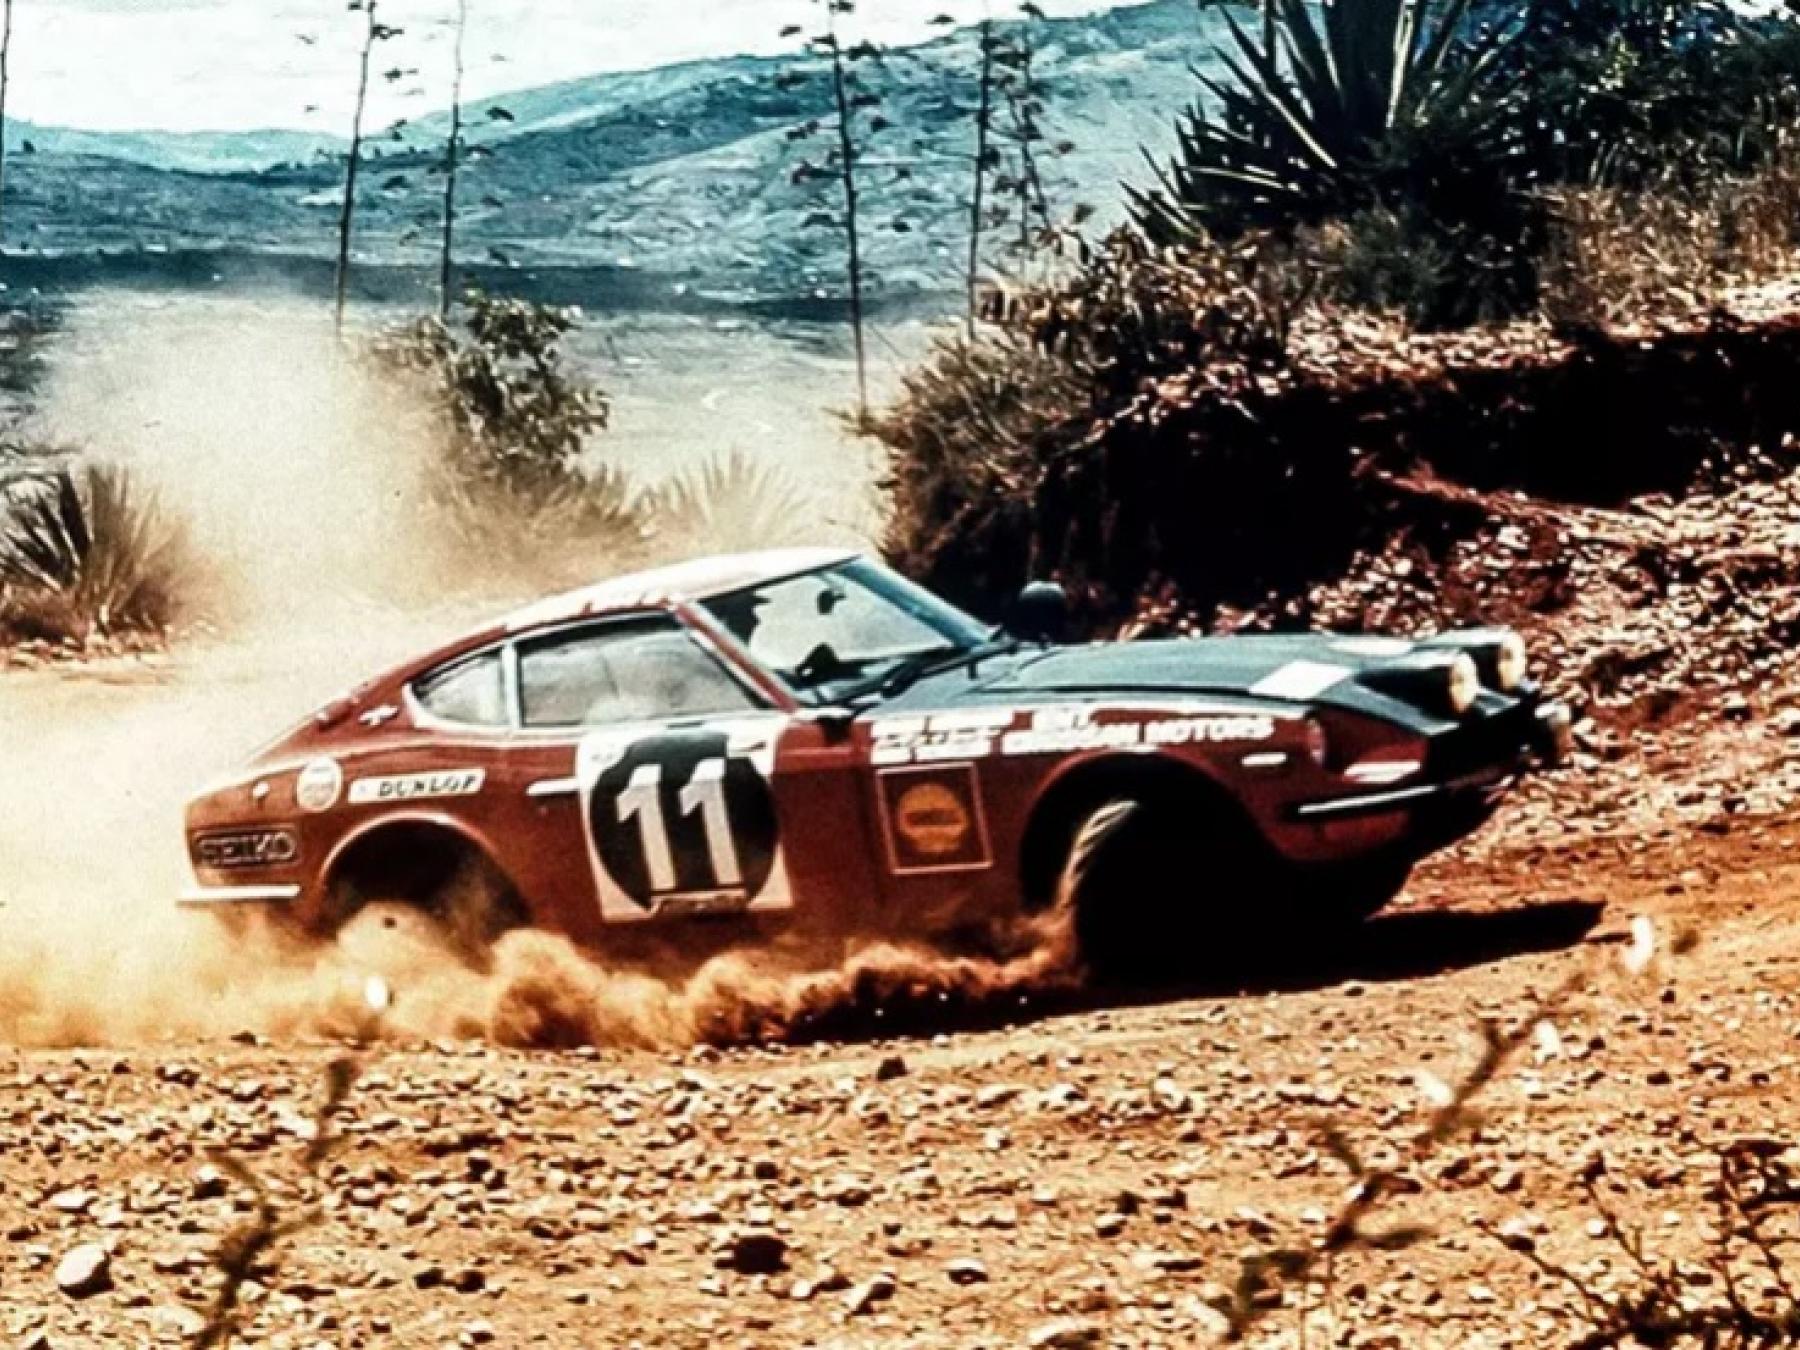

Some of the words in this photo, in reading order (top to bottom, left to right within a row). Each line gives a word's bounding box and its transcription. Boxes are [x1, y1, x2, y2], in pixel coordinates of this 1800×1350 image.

[1144, 717, 1274, 744] MOTORS
[379, 774, 477, 797] DUNLOP
[616, 757, 743, 890] 11
